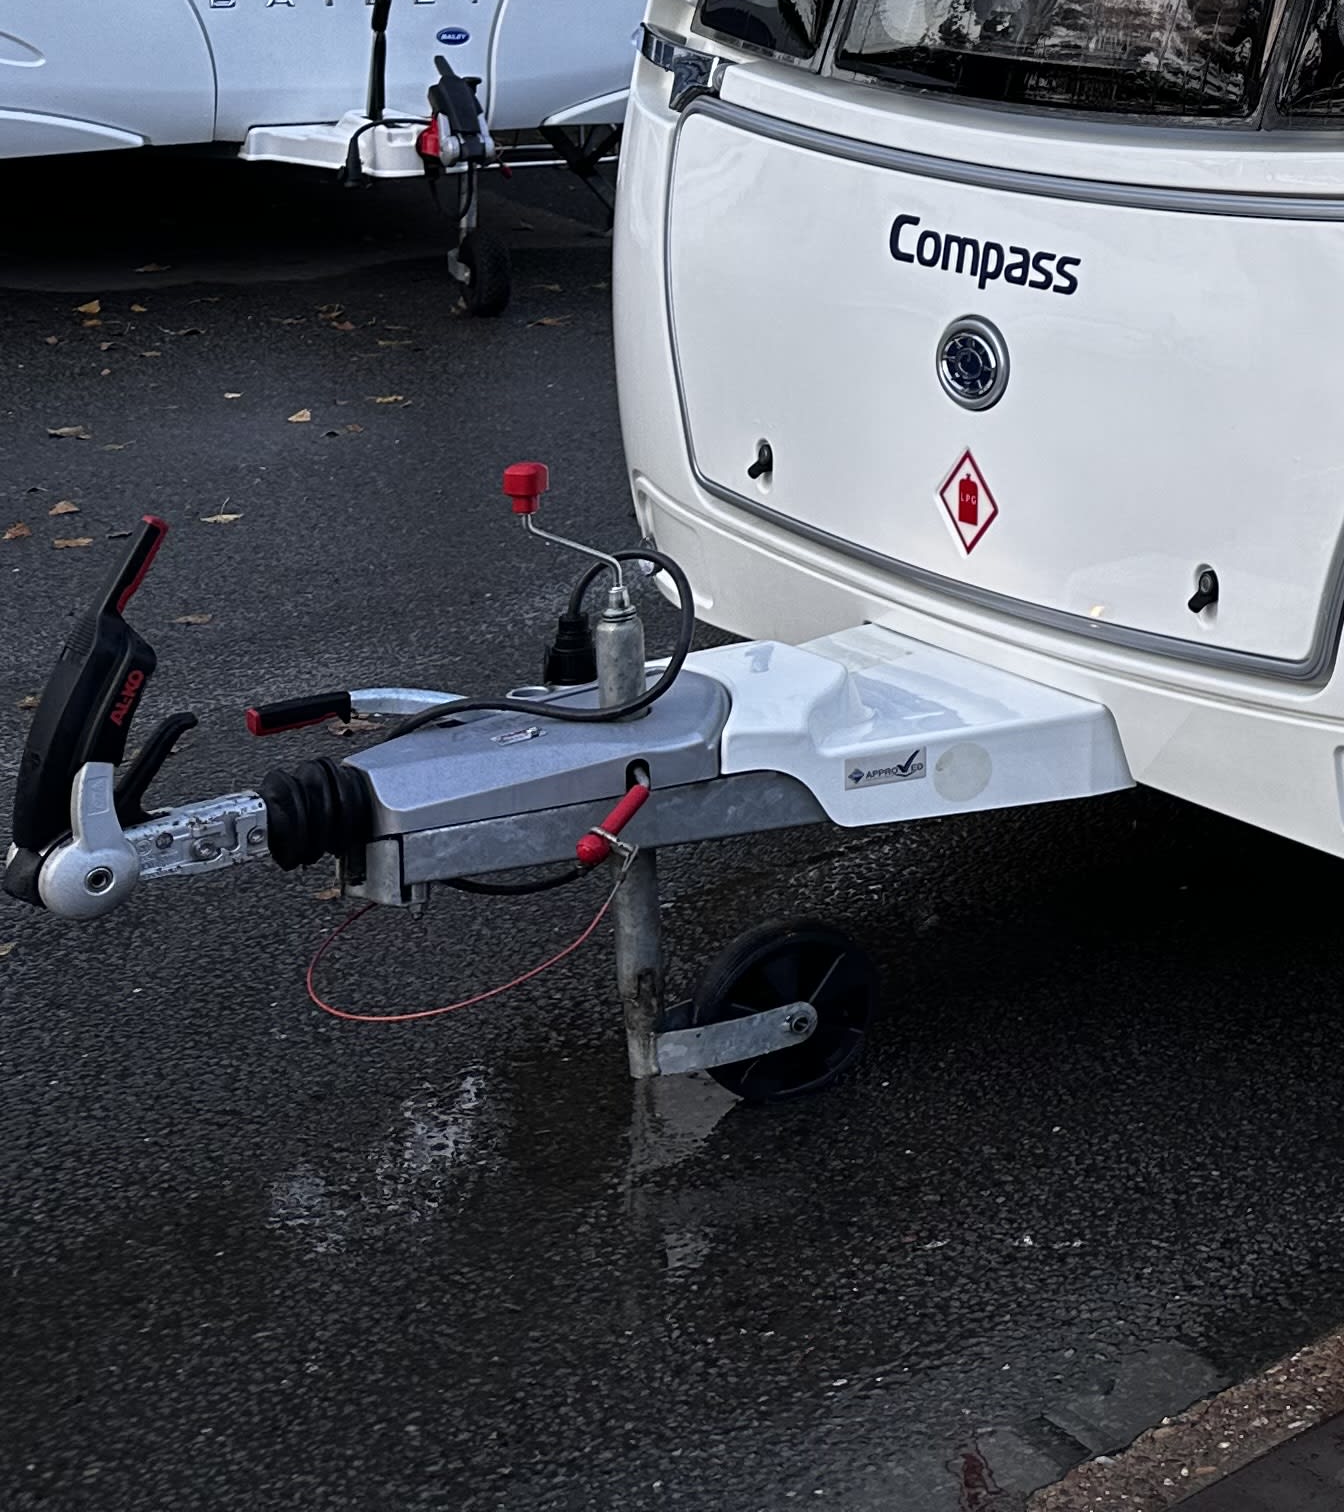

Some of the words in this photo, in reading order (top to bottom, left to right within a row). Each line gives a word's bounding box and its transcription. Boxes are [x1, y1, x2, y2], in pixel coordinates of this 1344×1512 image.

[889, 213, 1082, 296] Compass
[960, 492, 977, 505] LPG
[110, 670, 145, 727] AL-KO
